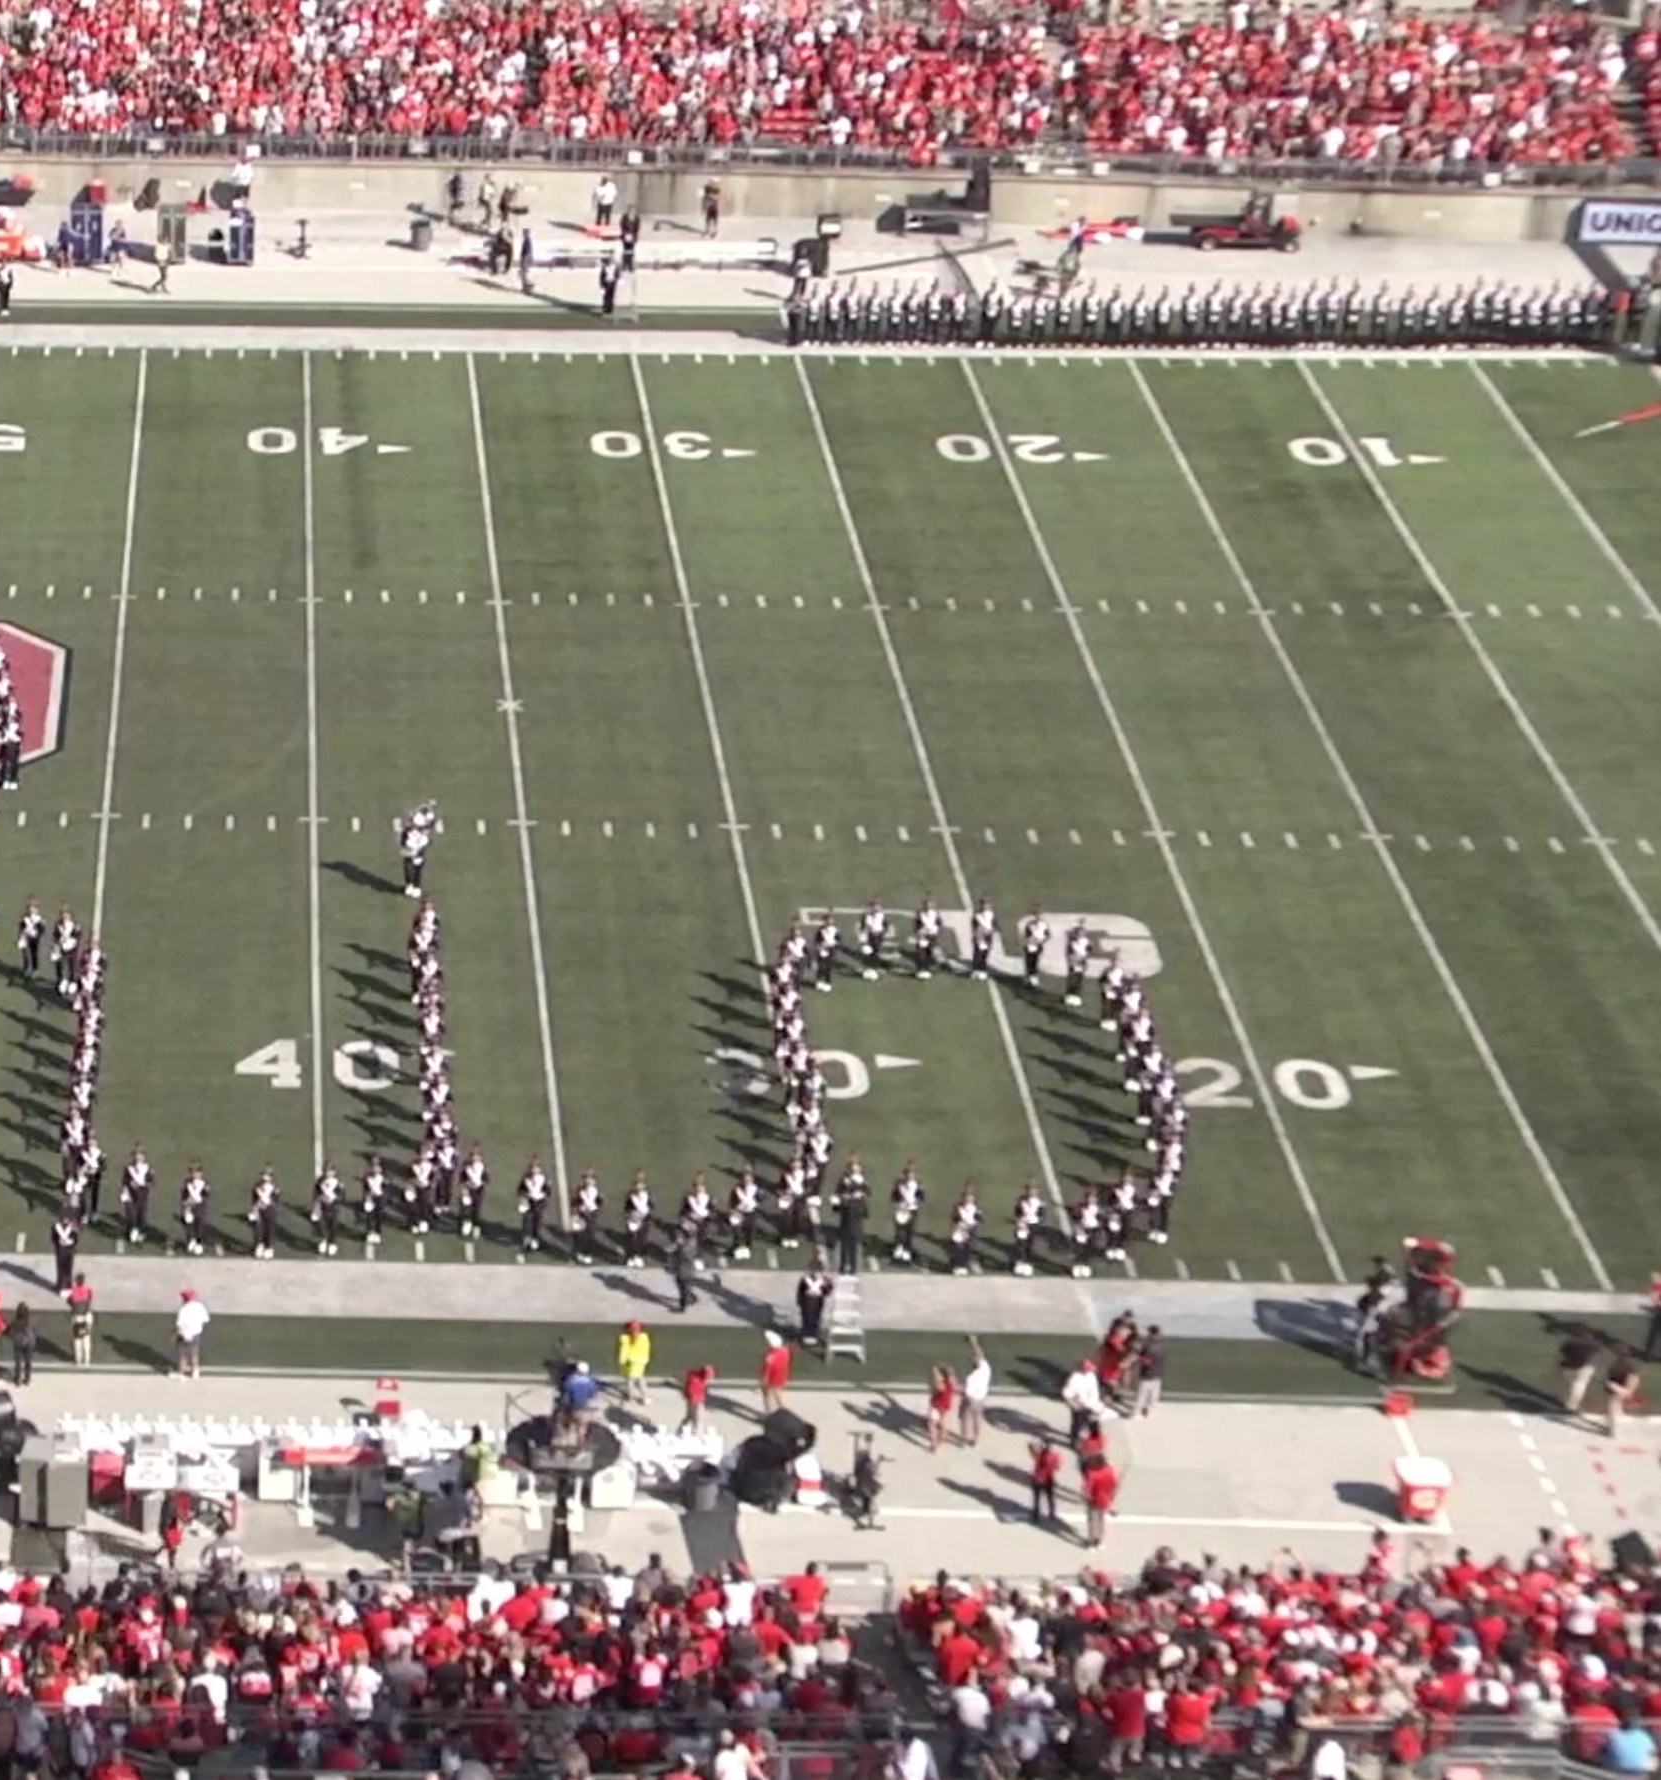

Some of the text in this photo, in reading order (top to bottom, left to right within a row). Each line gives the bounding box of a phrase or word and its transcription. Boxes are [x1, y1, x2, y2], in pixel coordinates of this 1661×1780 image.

[247, 427, 369, 455] 40
[590, 431, 710, 459] 30
[936, 434, 1065, 463] 20
[1288, 437, 1402, 466] 10
